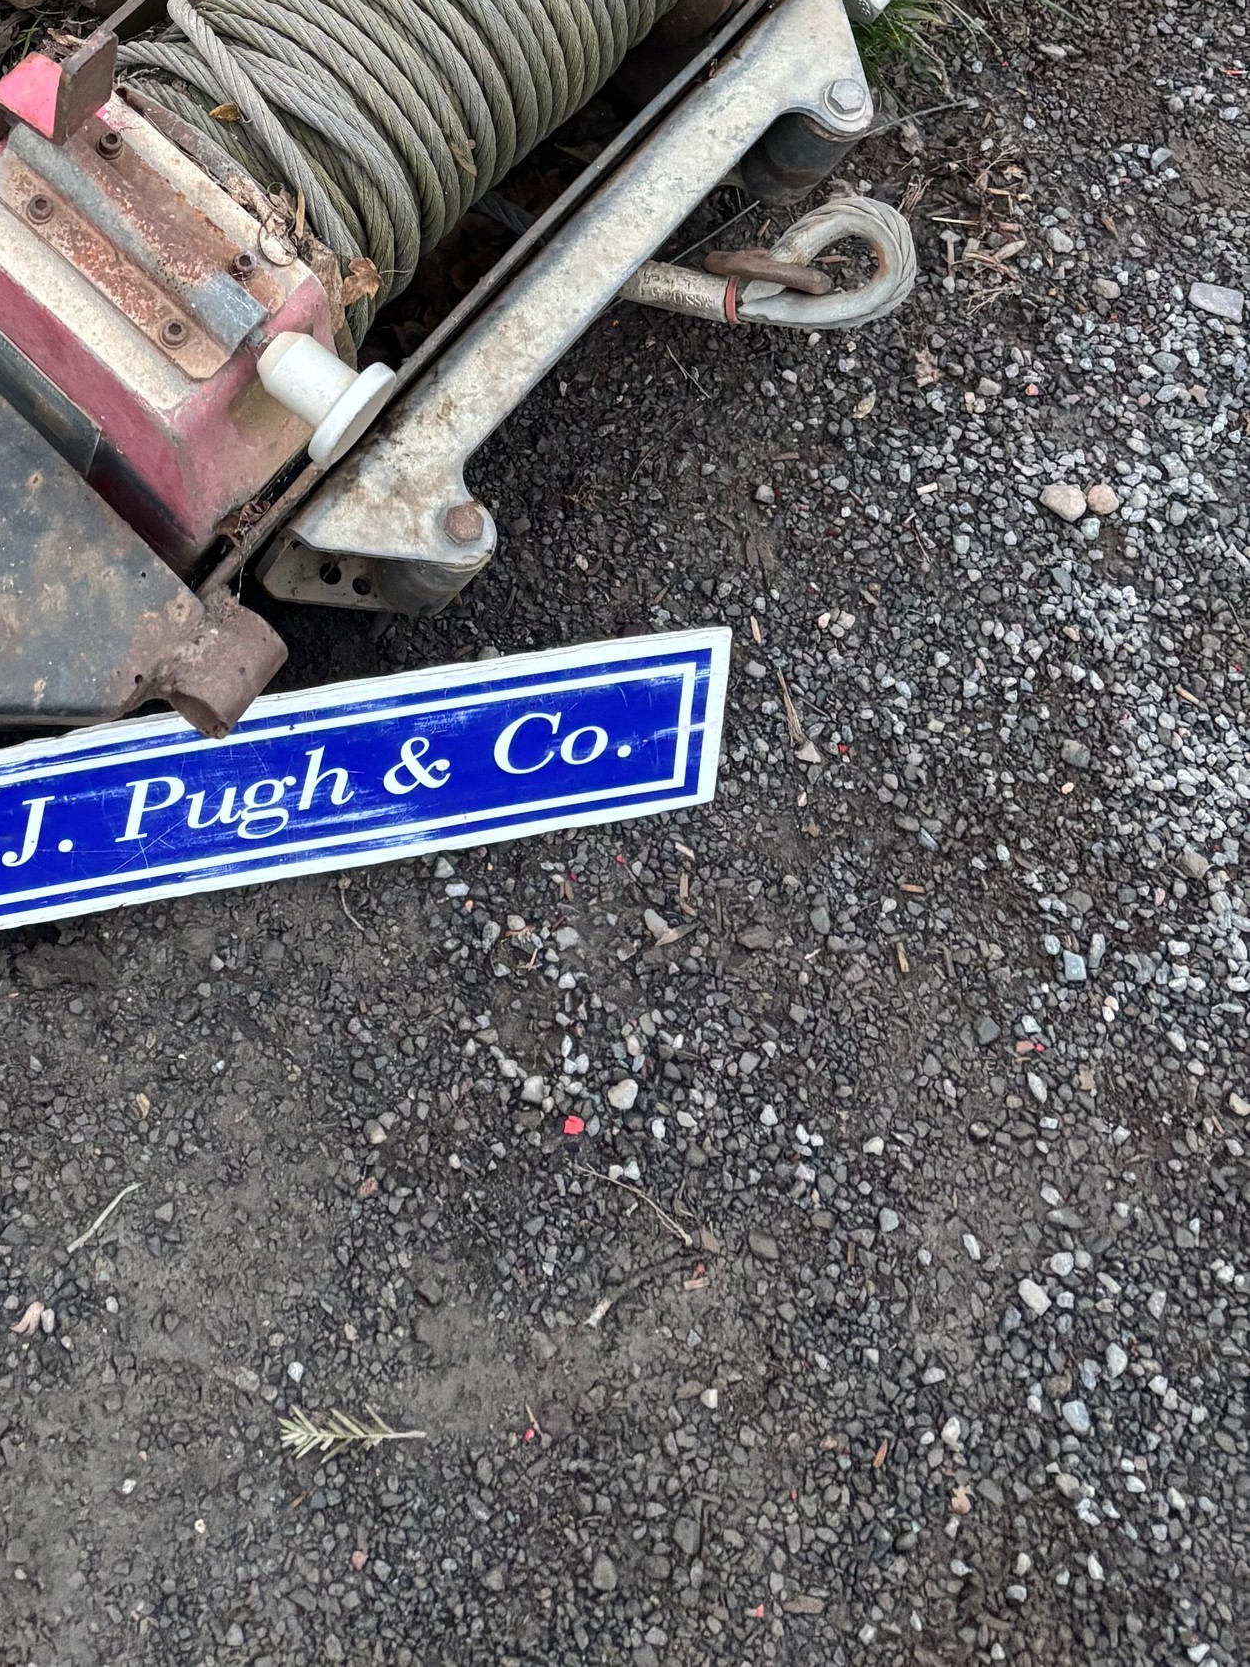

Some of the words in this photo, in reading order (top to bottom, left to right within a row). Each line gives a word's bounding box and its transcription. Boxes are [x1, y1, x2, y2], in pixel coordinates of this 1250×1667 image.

[1, 795, 74, 867] J.
[114, 745, 355, 843] Pugh
[383, 736, 451, 795] &
[493, 711, 632, 775] Co.
